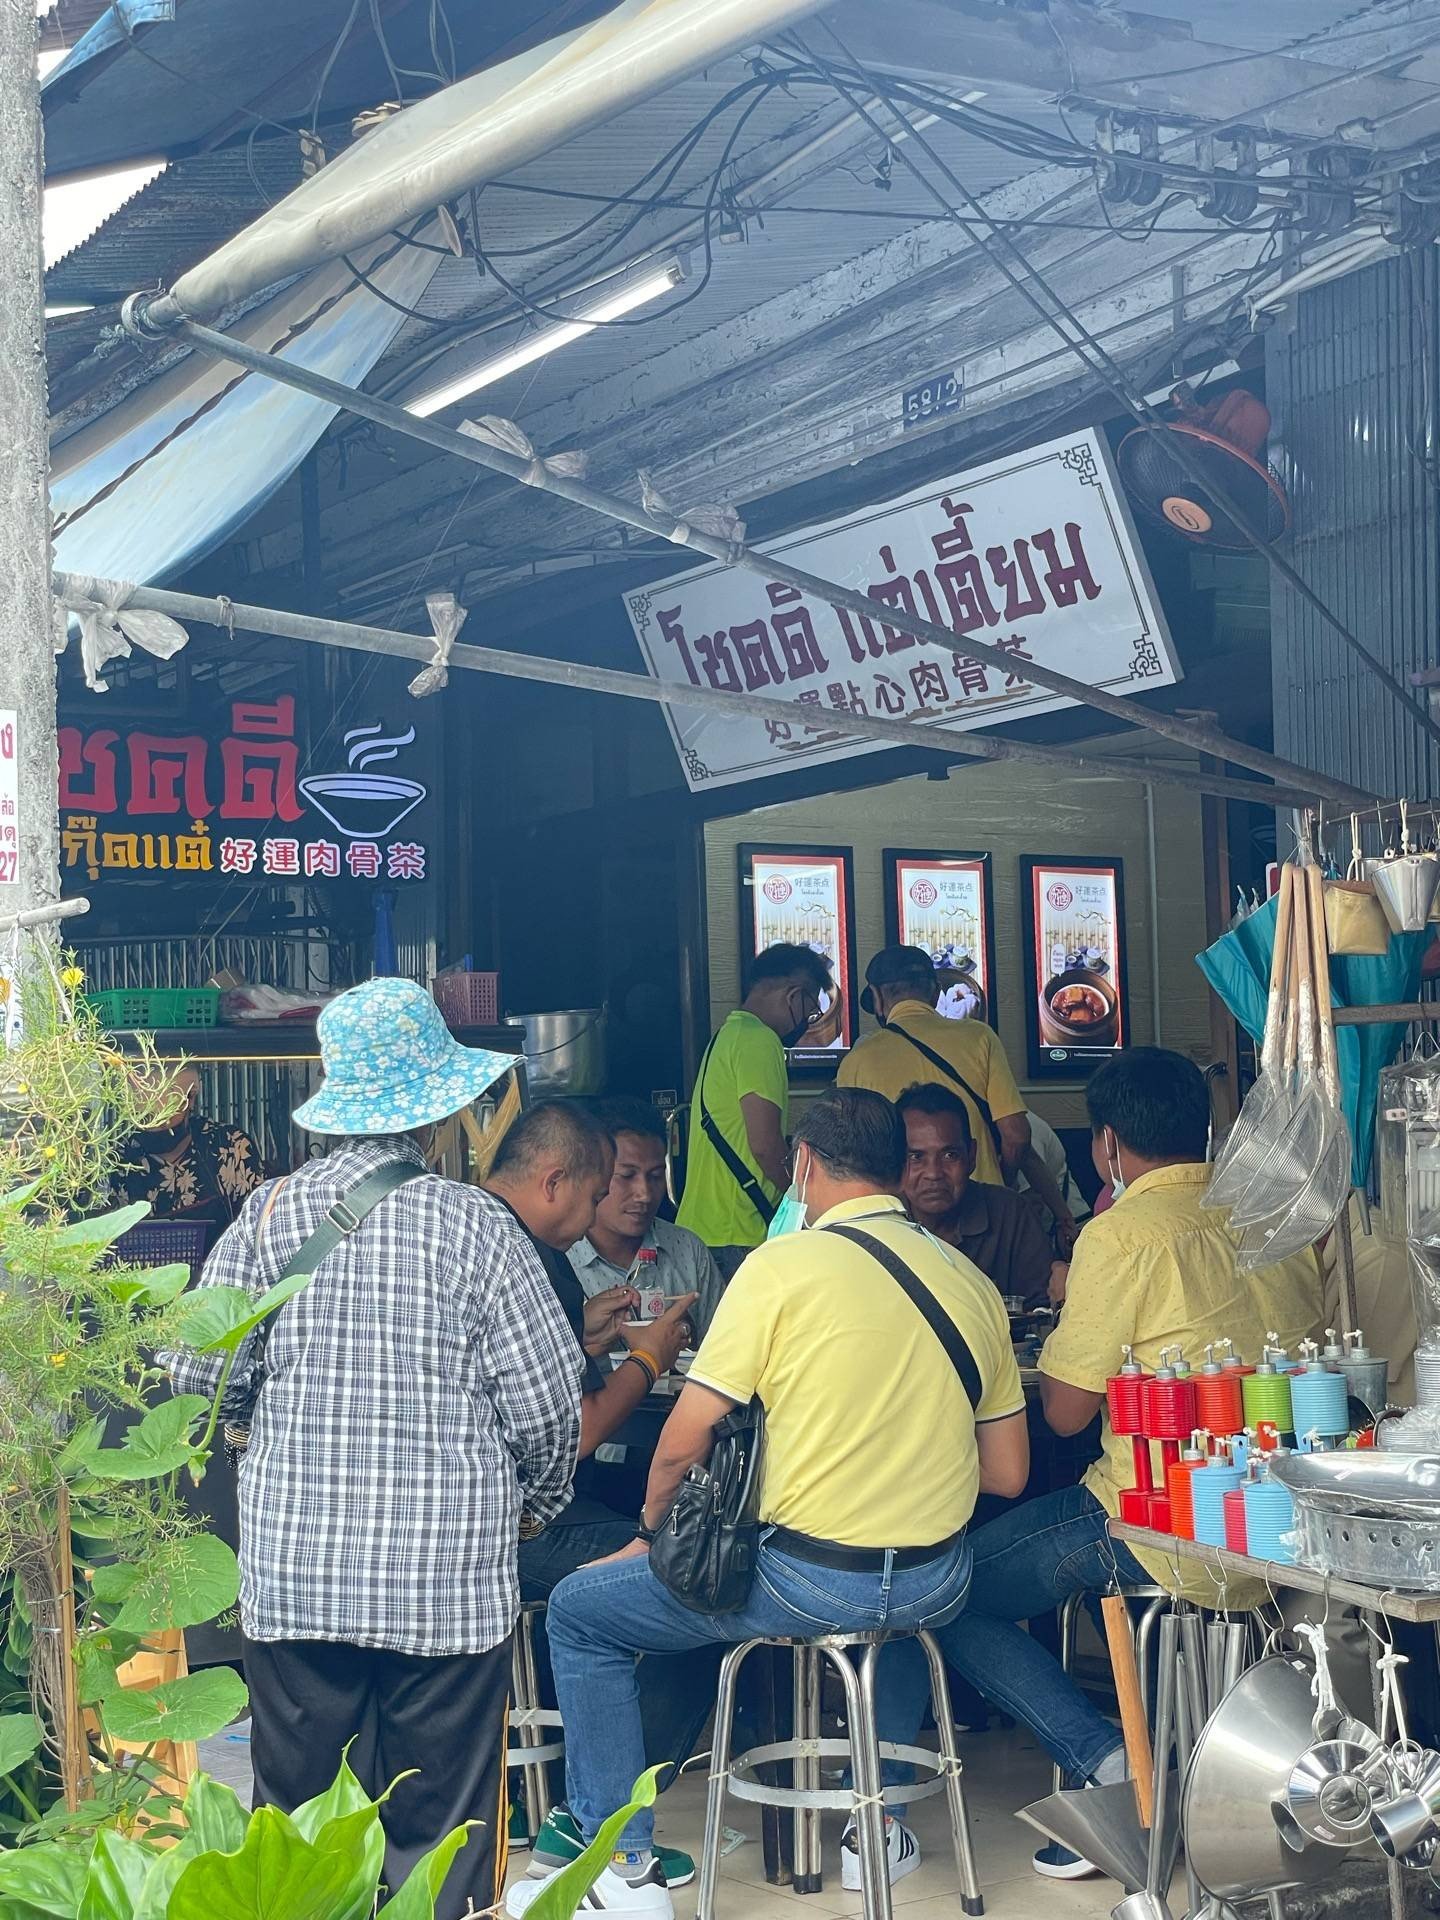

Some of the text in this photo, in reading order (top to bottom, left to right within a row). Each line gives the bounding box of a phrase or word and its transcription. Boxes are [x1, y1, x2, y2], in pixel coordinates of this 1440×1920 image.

[220, 837, 425, 879] 好運肉骨茶
